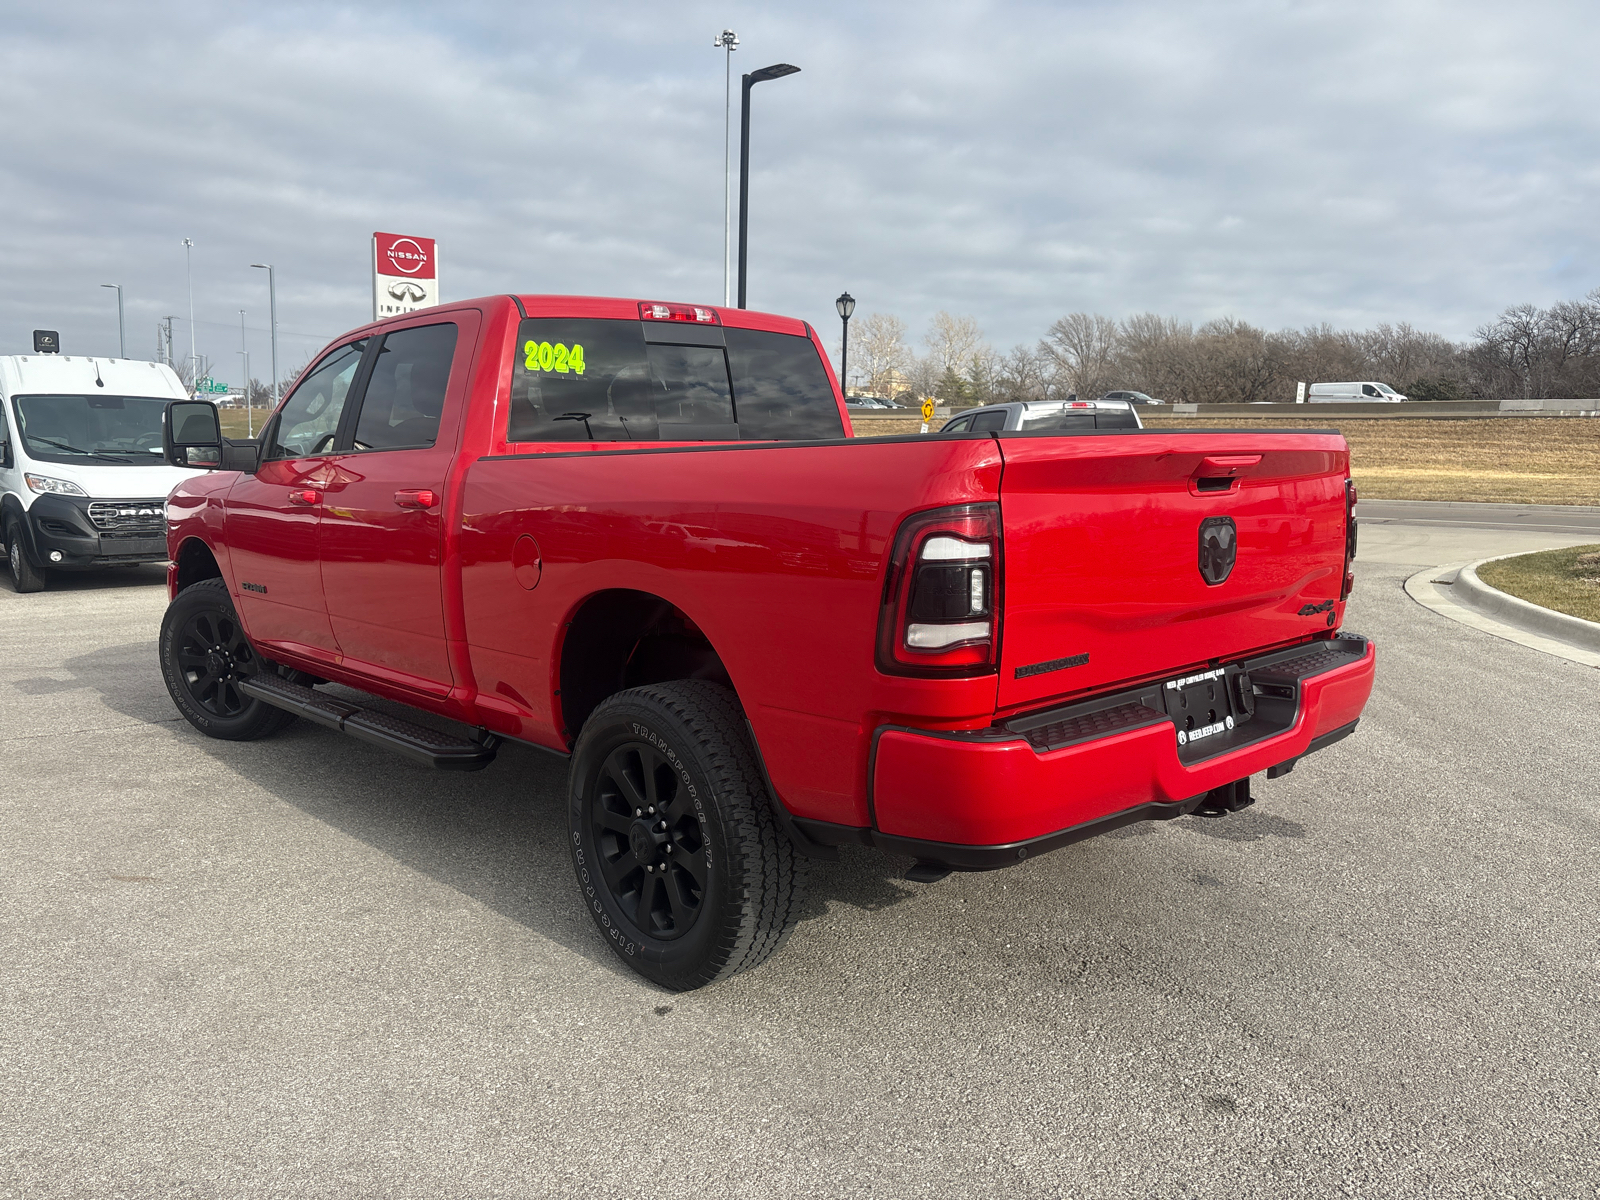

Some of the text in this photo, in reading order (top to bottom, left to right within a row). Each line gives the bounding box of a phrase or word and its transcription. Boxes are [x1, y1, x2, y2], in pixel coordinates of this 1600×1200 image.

[387, 250, 427, 261] NISSAN
[380, 304, 421, 314] INFIN
[524, 340, 586, 375] 2024
[632, 722, 707, 824] TRANSFORCE
